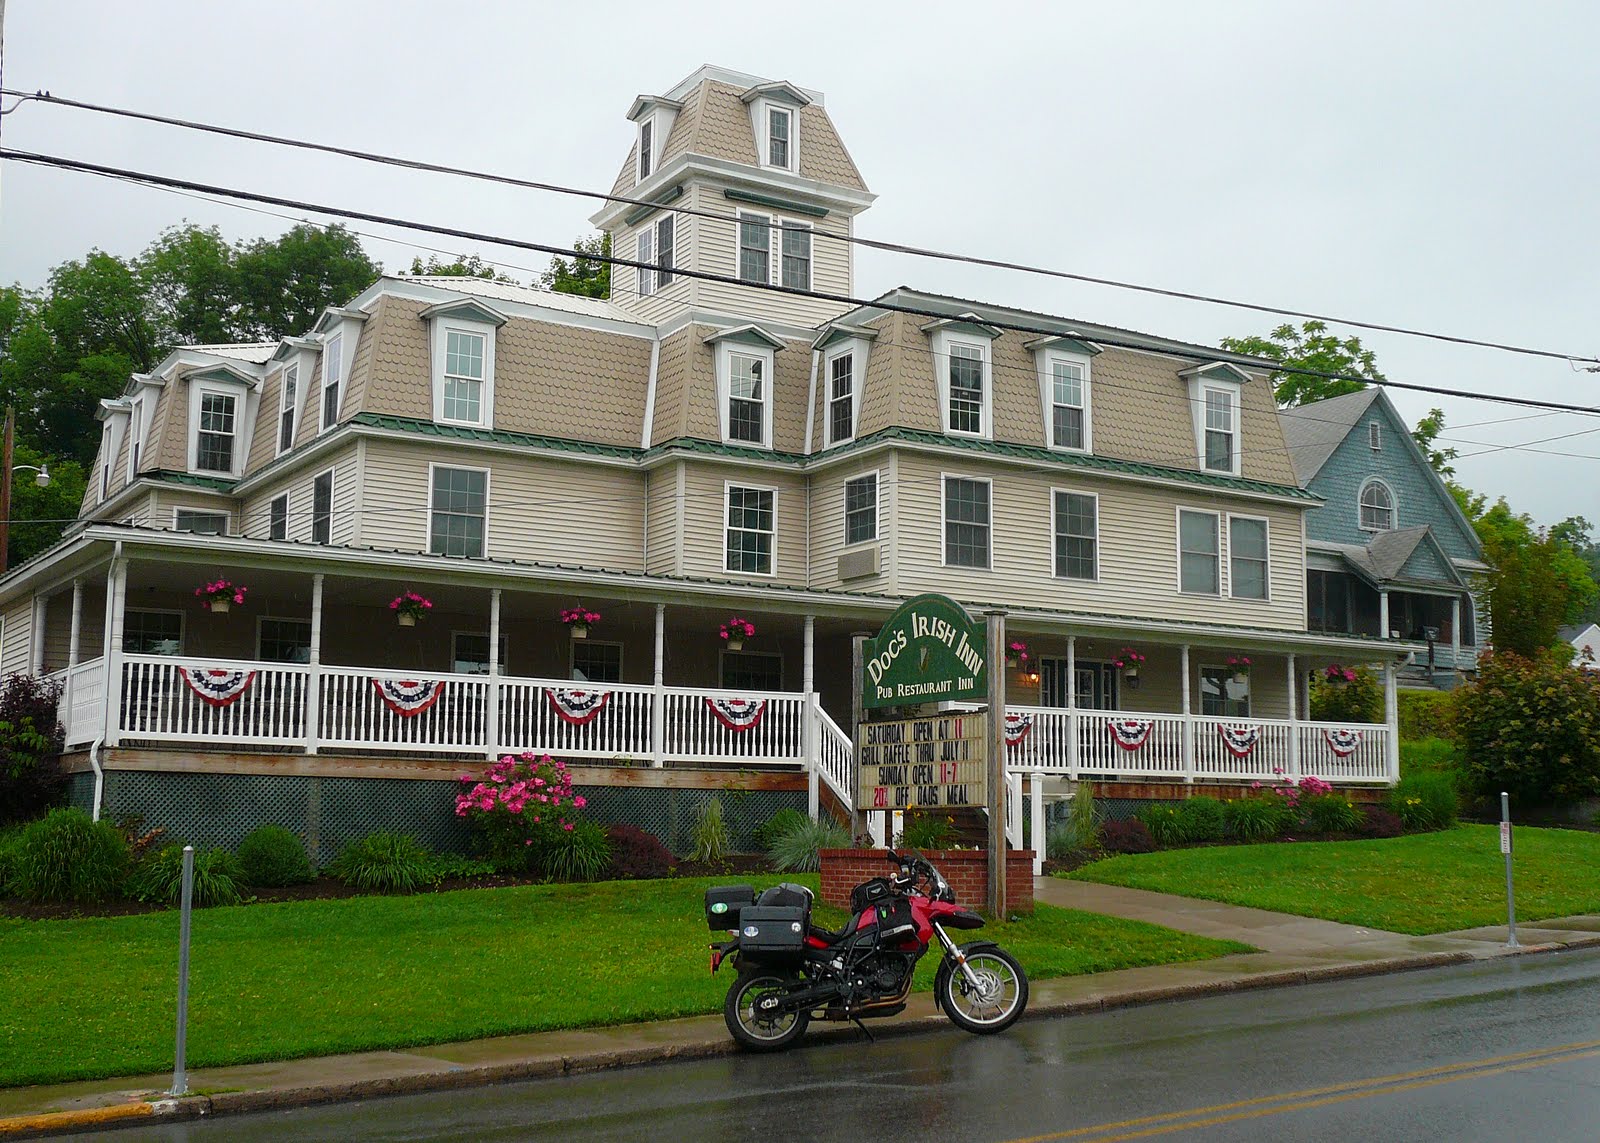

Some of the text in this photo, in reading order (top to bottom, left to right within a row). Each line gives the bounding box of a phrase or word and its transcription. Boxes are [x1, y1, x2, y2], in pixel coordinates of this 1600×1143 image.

[911, 612, 957, 648] IRISH
[955, 631, 984, 677] INN
[877, 677, 974, 699] PUB RESTAURANT INN
[867, 718, 962, 745] SATURDAY OPEN AT 11
[861, 746, 880, 766] GRILL
[883, 744, 911, 764] RAFFLE
[915, 743, 935, 763] THRU
[940, 740, 959, 761] JULY
[878, 765, 908, 785] SUNDAY
[912, 764, 933, 785] OPEN
[895, 786, 910, 806] OFF
[917, 785, 939, 805] DADS
[946, 784, 969, 805] MEAL
